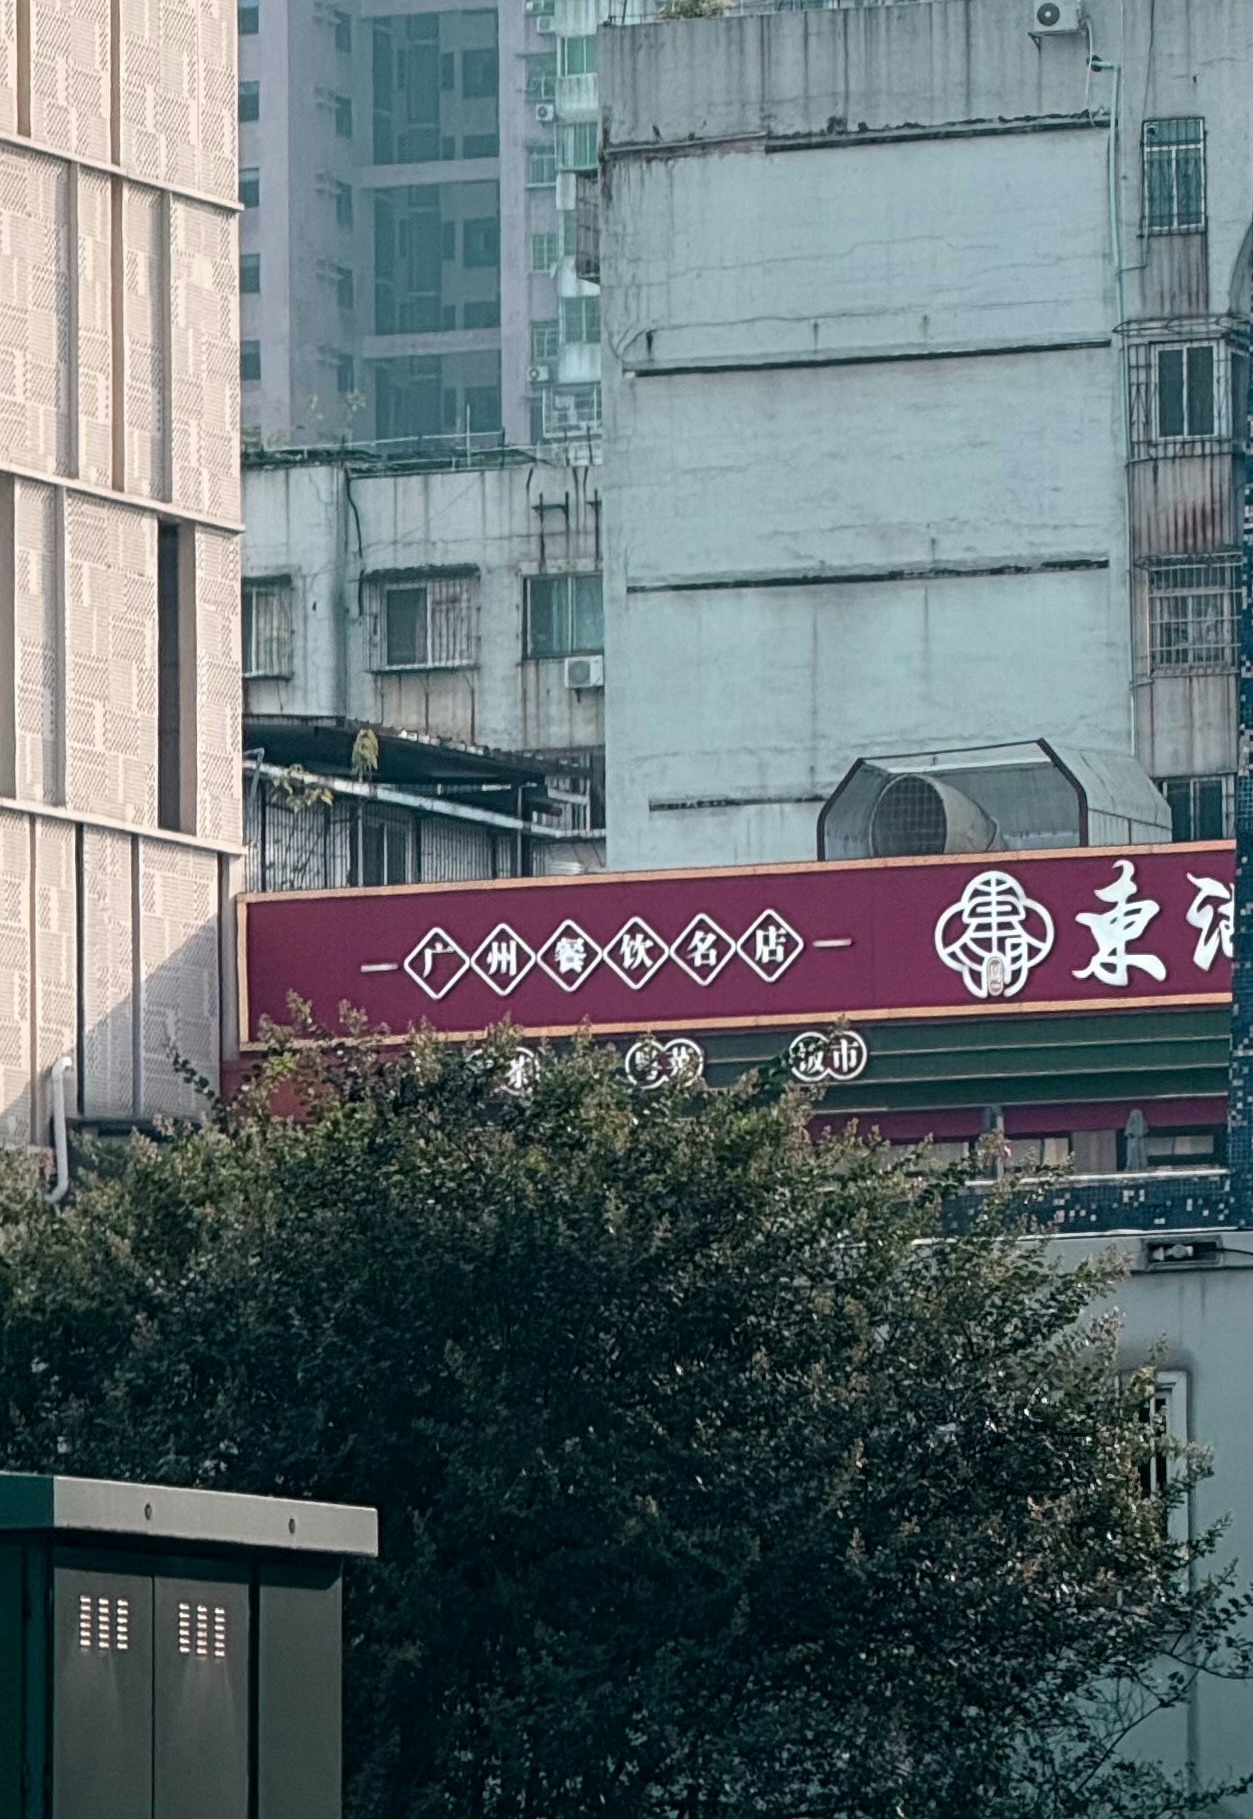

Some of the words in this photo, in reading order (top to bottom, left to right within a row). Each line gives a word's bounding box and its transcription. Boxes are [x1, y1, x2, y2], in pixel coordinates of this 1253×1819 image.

[422, 925, 787, 978] 广州餐饮名店
